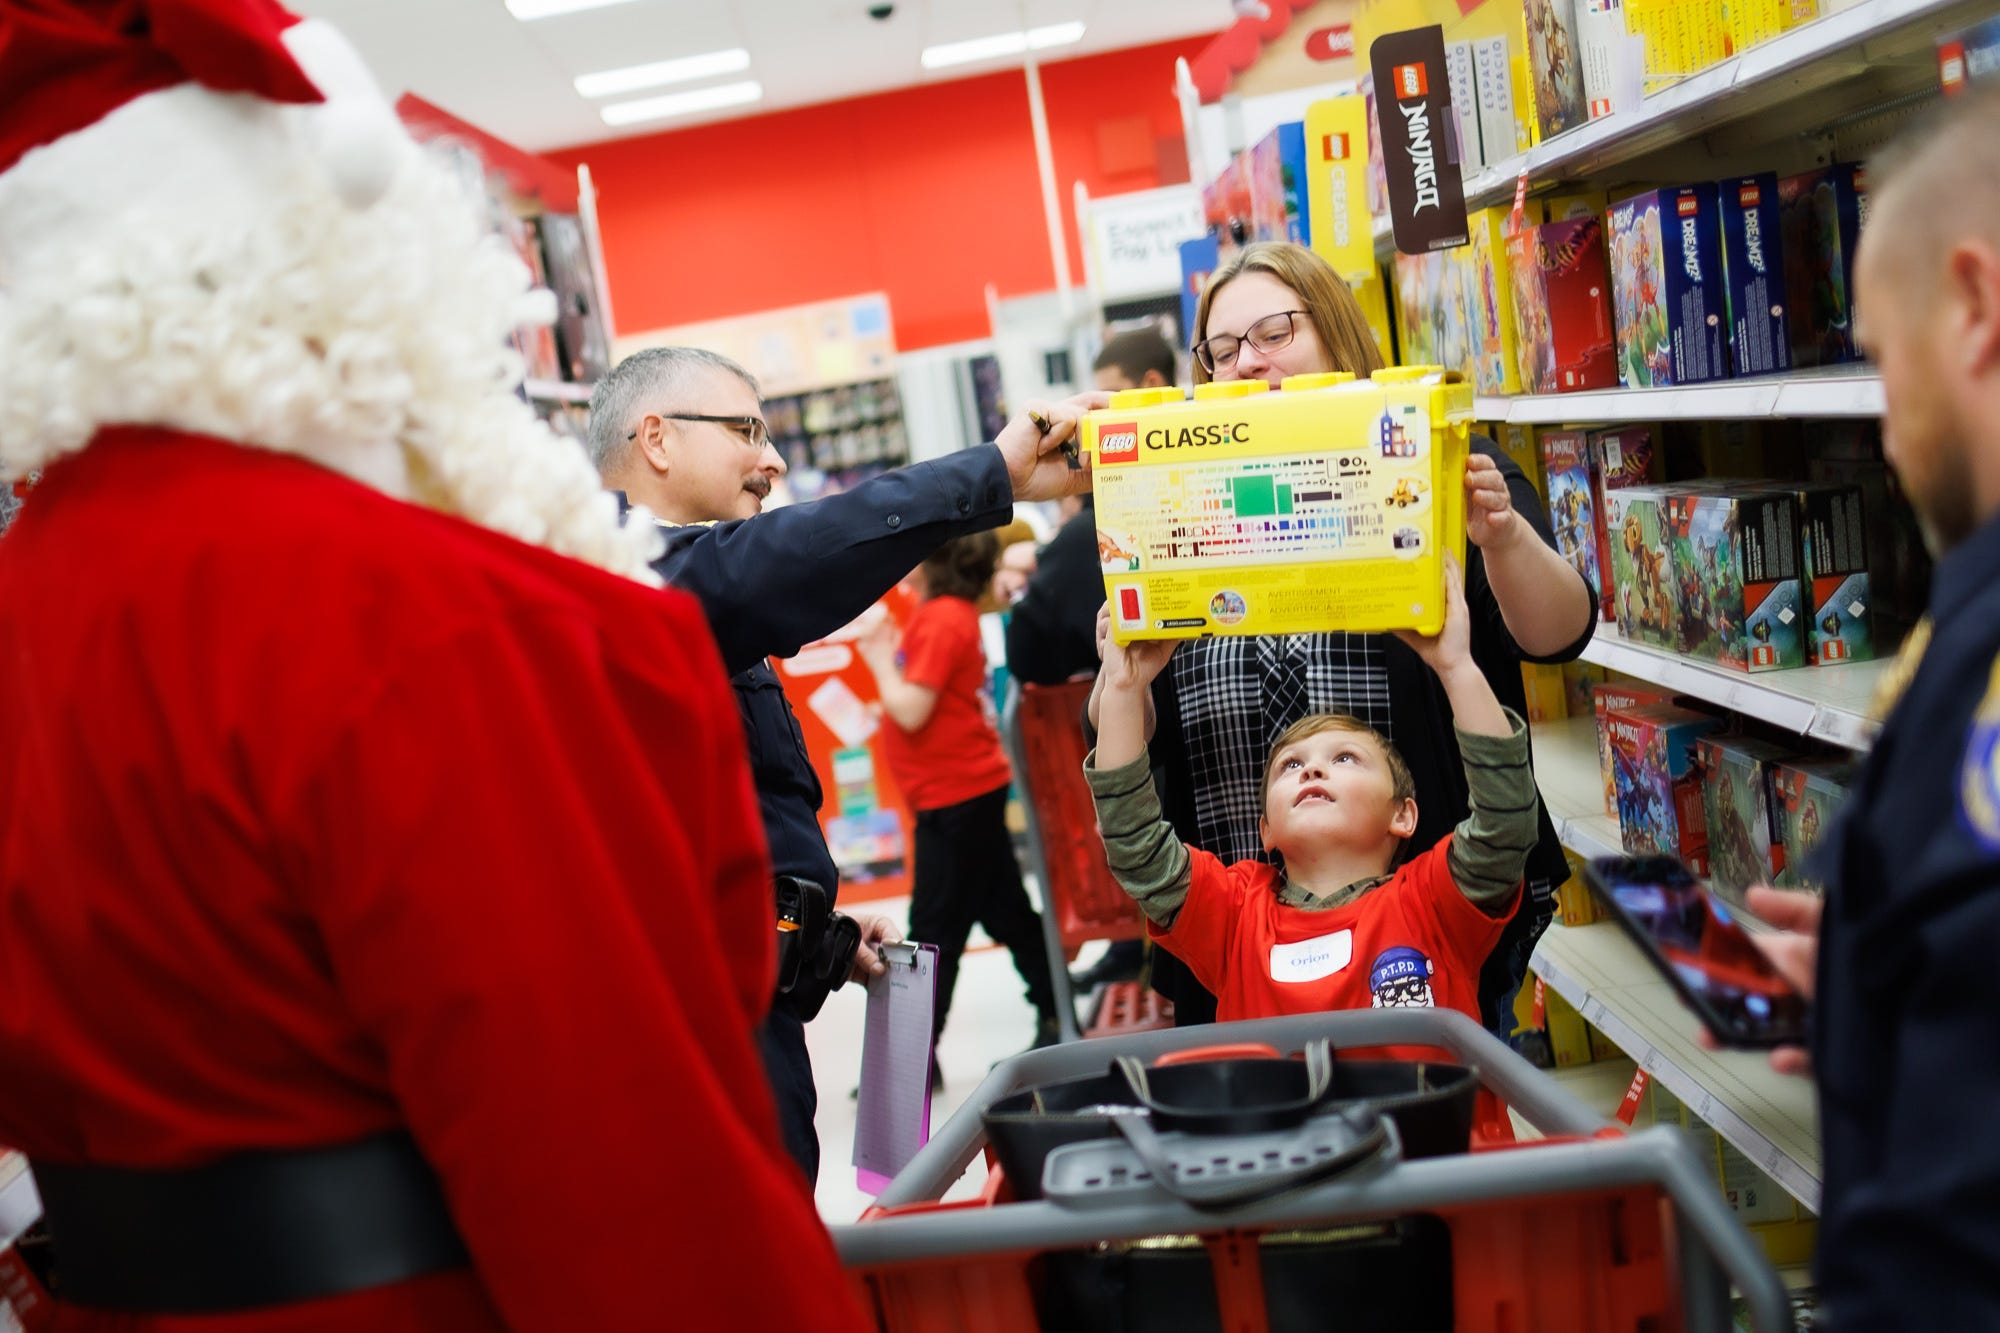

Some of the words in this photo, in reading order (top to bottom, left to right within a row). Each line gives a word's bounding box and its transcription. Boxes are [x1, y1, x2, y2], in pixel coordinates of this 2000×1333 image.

[1402, 65, 1420, 96] LEGO
[1398, 100, 1440, 219] NINJAGO
[1329, 166, 1349, 248] CREATOR
[1101, 432, 1136, 454] LEGO
[1290, 951, 1330, 968] Orion
[1380, 961, 1418, 979] P.T.P.D.
